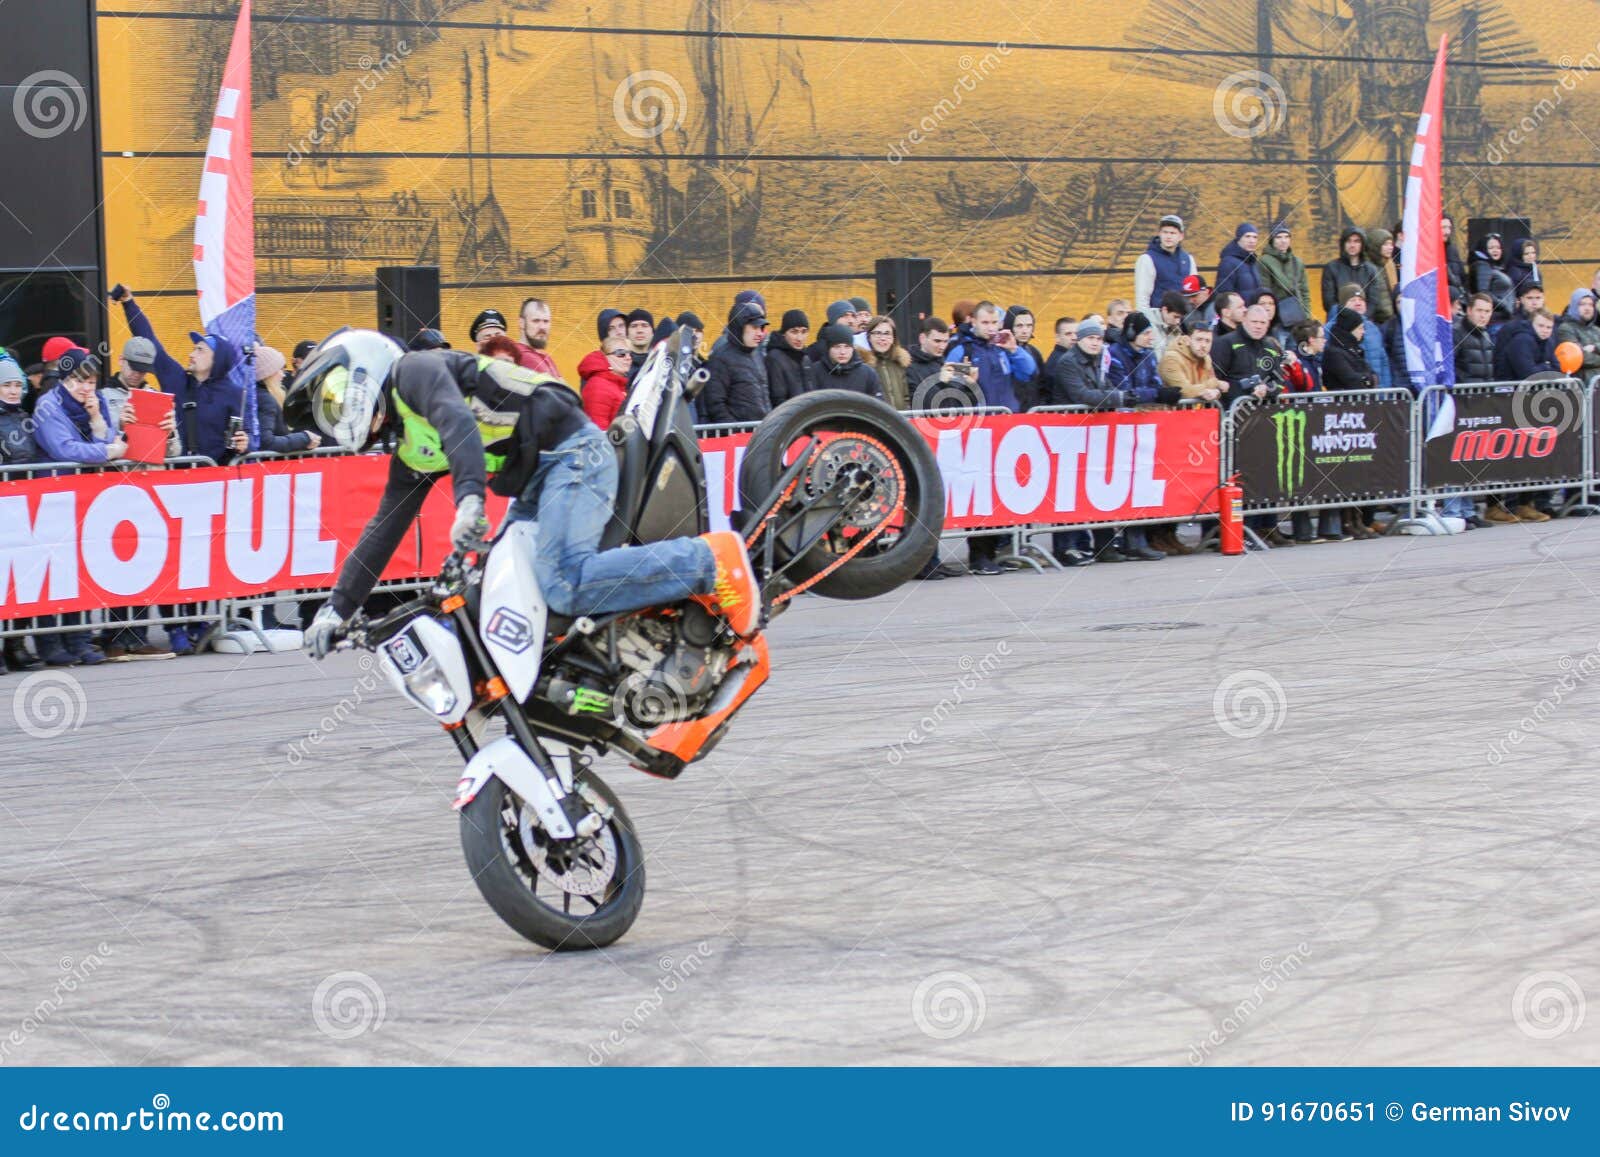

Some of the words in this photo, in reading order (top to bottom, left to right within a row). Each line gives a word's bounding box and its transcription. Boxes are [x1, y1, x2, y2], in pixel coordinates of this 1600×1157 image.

[1324, 413, 1366, 432] BLACK
[936, 423, 1167, 518] MOTUL
[0, 471, 338, 606] MOTUL
